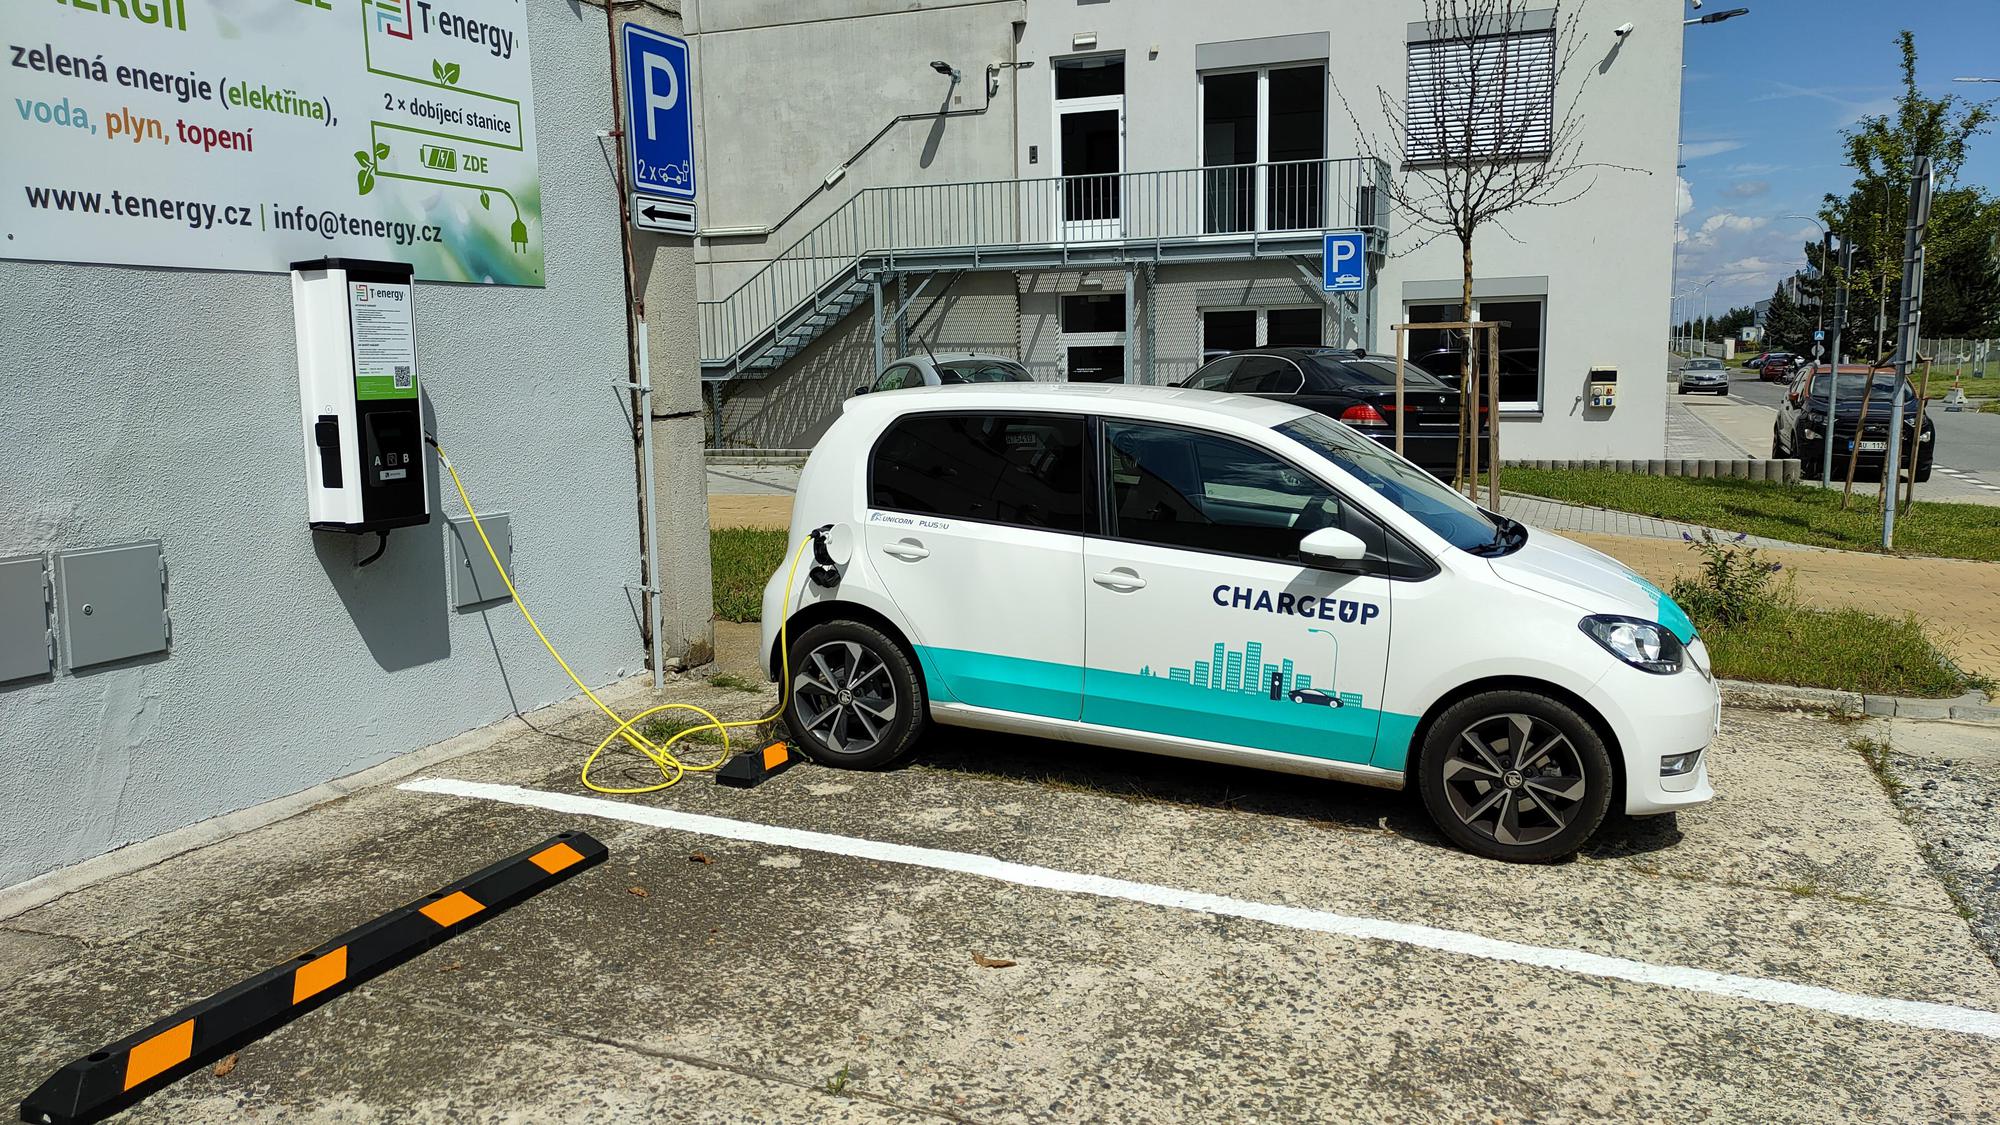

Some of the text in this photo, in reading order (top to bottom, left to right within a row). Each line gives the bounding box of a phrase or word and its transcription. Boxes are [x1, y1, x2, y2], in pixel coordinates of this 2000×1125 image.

[9, 43, 338, 127] zelená energie (elektřina),
[642, 50, 679, 141] P
[15, 97, 253, 153] voda, plyn, topení
[383, 92, 394, 111] 2
[410, 98, 463, 125] dobíjecí
[466, 111, 512, 134] stanice
[462, 154, 489, 174] ZDE
[638, 159, 647, 179] 2
[25, 186, 443, 246] www.tenergy.cz info@tenergy.cz
[1332, 240, 1355, 272] P
[374, 453, 410, 466] A B
[882, 515, 914, 525] UNICORN
[1212, 584, 1380, 625] CHARGEUP
